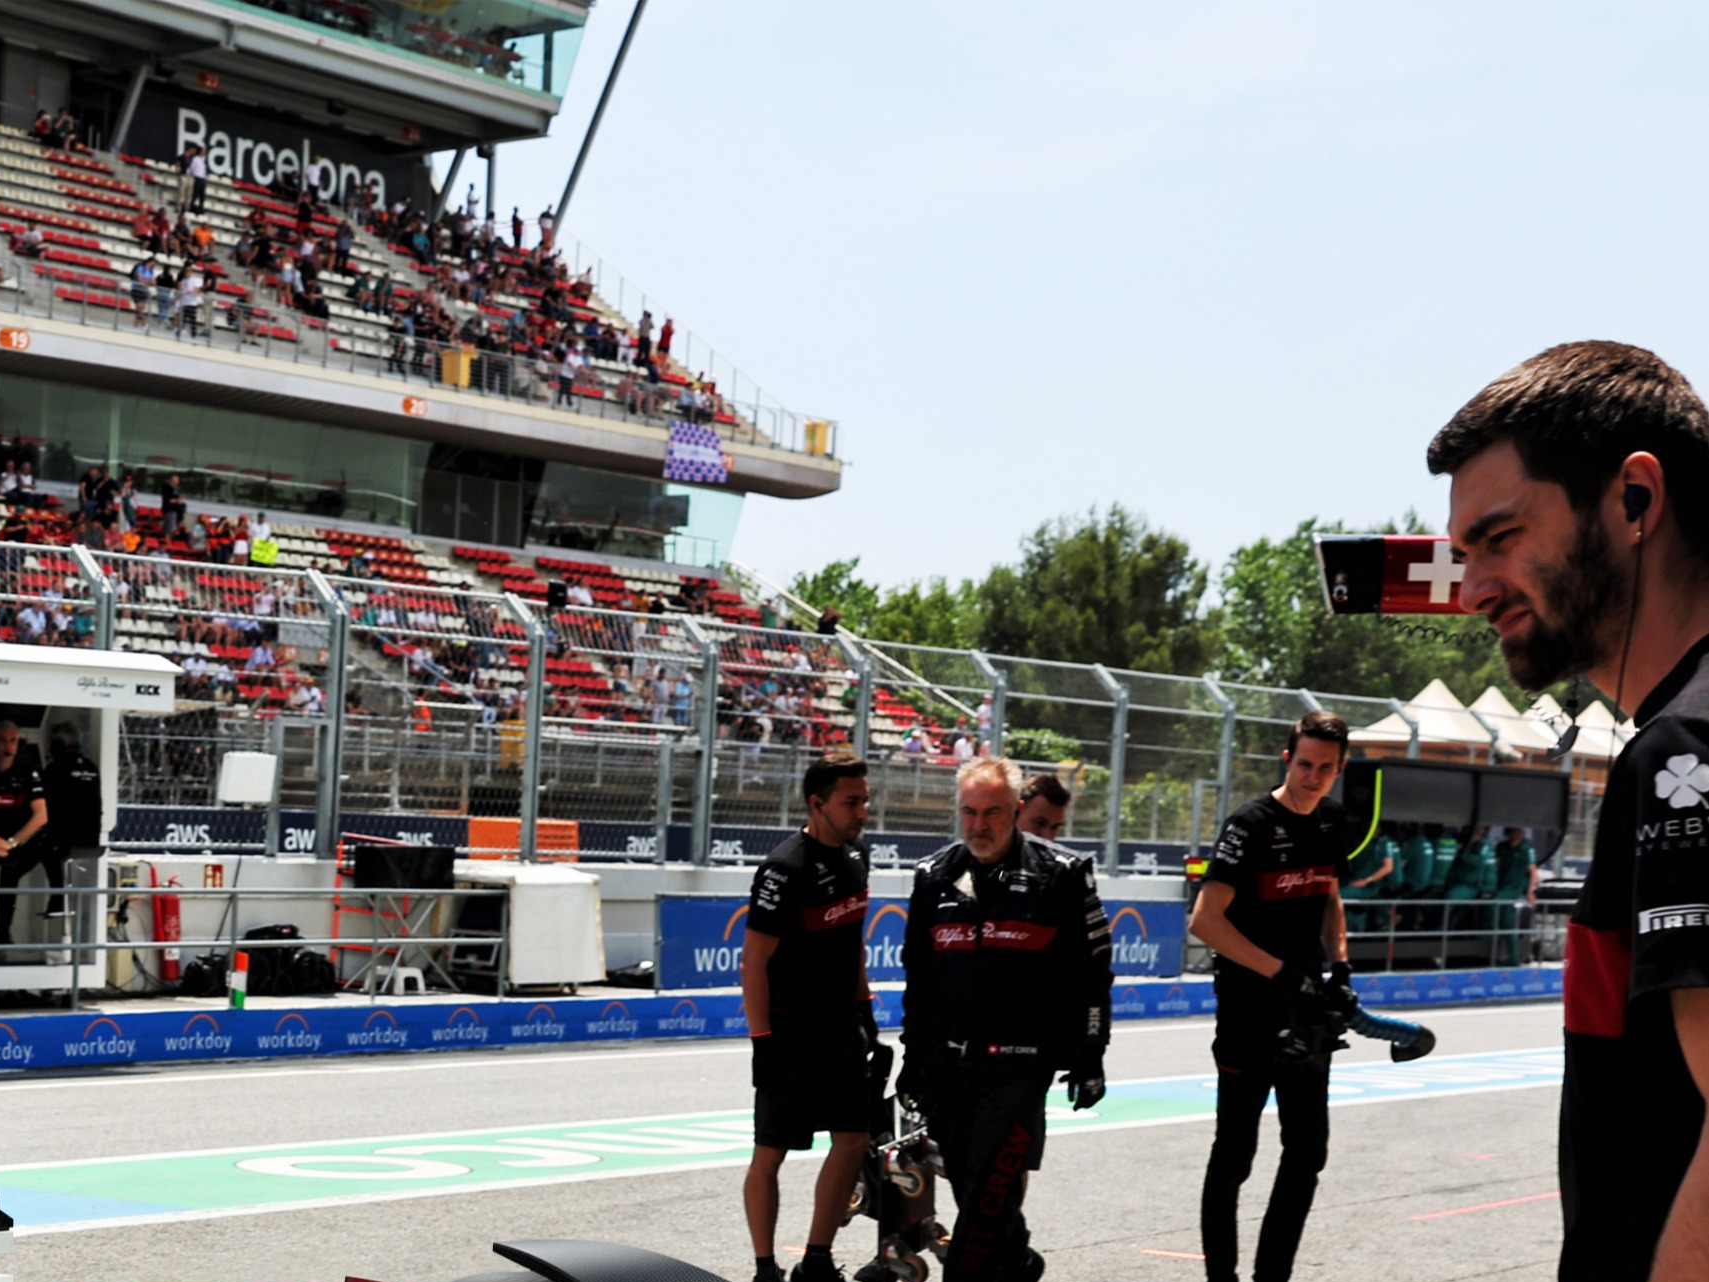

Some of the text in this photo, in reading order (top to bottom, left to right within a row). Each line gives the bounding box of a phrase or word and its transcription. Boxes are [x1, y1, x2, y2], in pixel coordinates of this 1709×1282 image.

[135, 684, 161, 696] KICK
[165, 823, 212, 844] aws
[284, 827, 317, 851] aw
[712, 840, 743, 859] aws
[1638, 903, 1709, 935] PIRE
[347, 1026, 408, 1046] workday
[432, 1022, 488, 1042] workday
[512, 1019, 566, 1038] workday
[64, 1035, 136, 1057] workday
[164, 1032, 232, 1052] workday
[258, 1029, 321, 1050] workday
